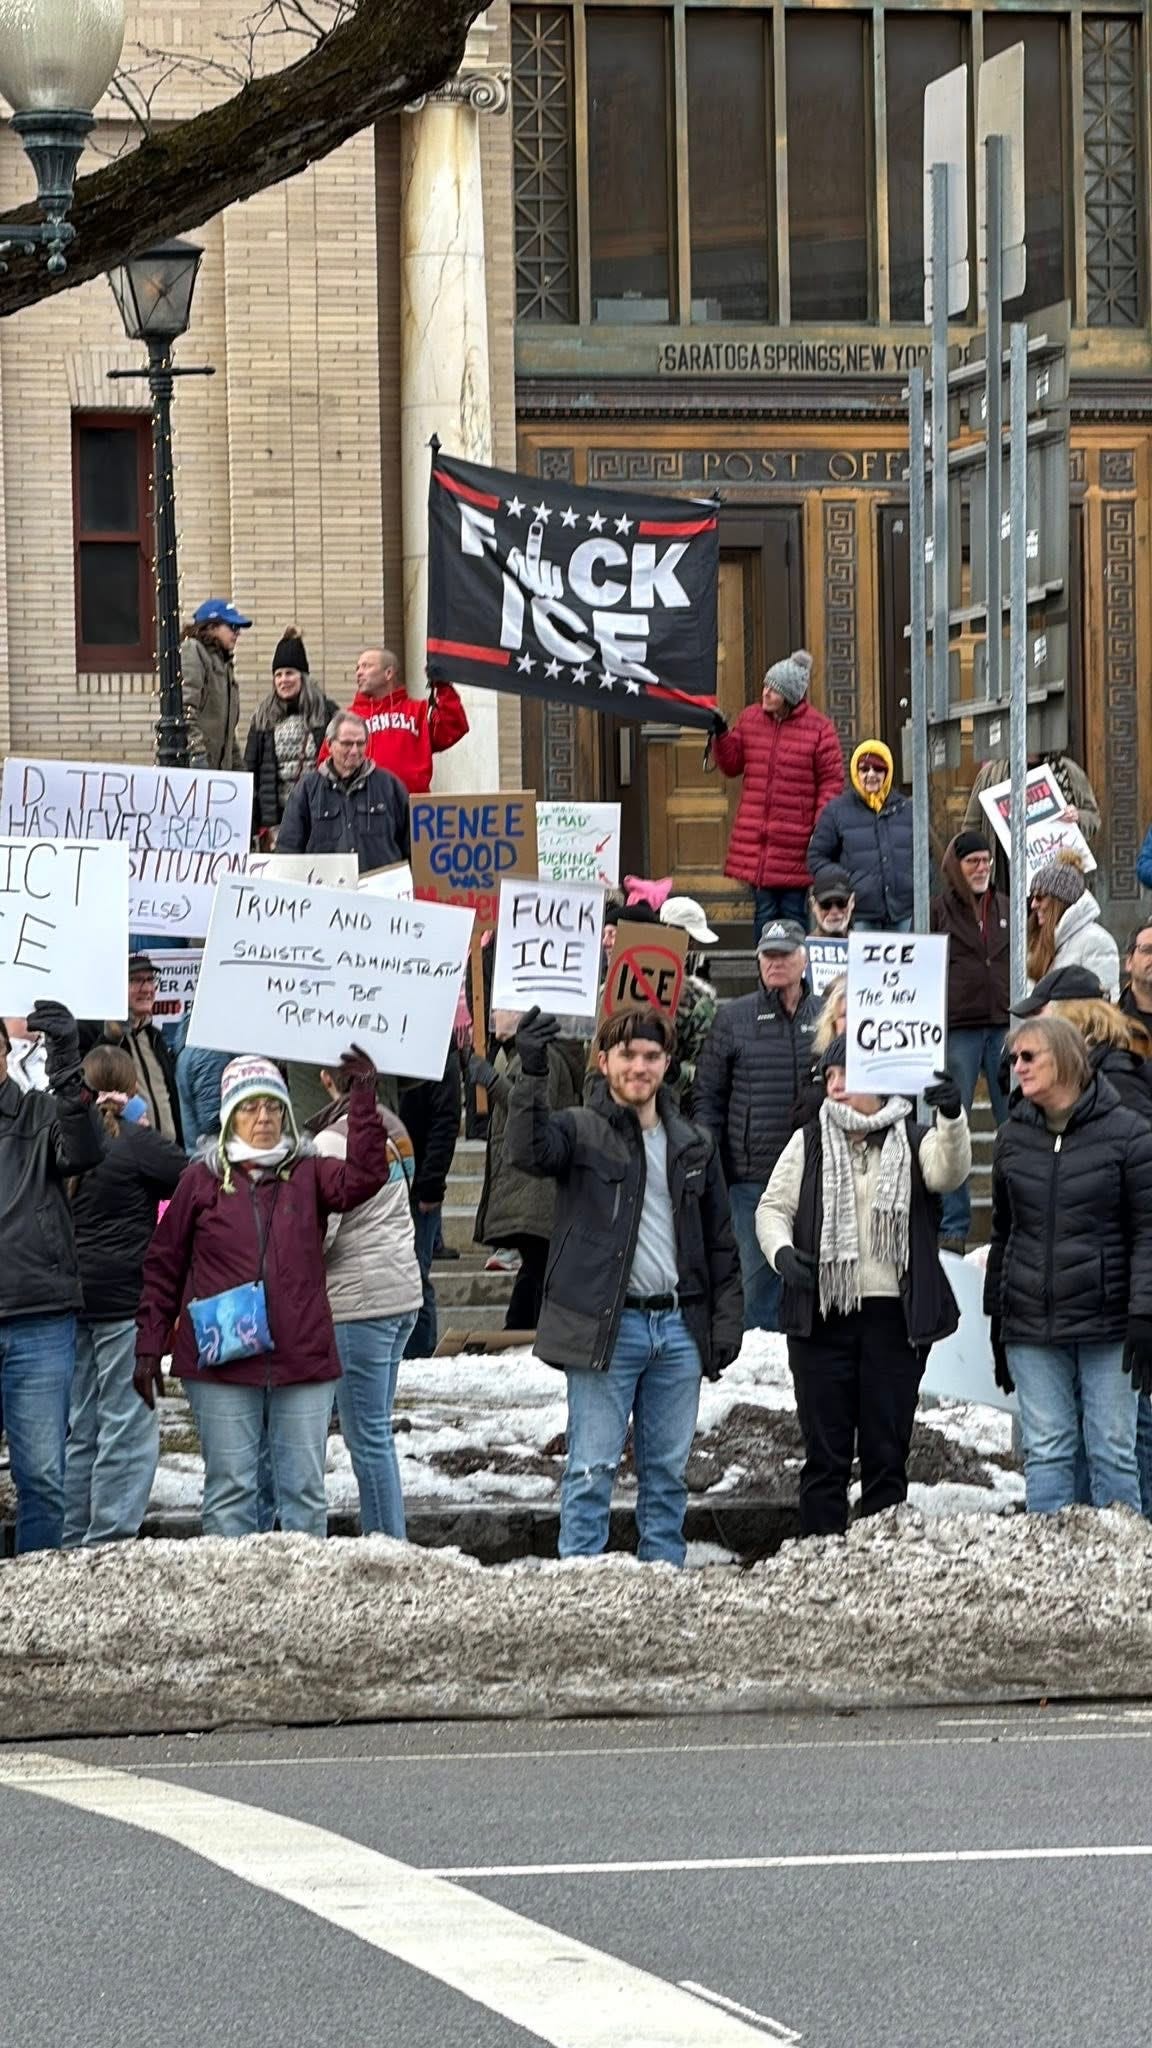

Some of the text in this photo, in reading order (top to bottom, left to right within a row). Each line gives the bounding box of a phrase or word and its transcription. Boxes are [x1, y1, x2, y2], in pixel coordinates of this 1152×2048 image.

[664, 343, 761, 372] SARATOGA
[846, 343, 887, 372] NEW
[892, 343, 933, 371] YOR
[703, 450, 903, 481] POST OFF
[500, 572, 660, 685] ICE
[365, 711, 419, 737] RNELL
[22, 765, 238, 818] D TRUMP
[8, 803, 59, 840] HAS
[63, 807, 153, 850] NEVER
[411, 803, 526, 843] RENEE
[129, 847, 249, 885] TITUTION
[429, 838, 518, 875] GOOD
[448, 872, 495, 890] WAS
[230, 884, 427, 939] TRUMP AND HIS
[512, 891, 595, 937] FUCK
[512, 937, 585, 974] ICE
[863, 942, 916, 965] ICE
[184, 979, 198, 993] A
[267, 976, 384, 1002] MUST BE
[616, 962, 676, 1009] ICE
[882, 969, 901, 988] IS
[184, 1000, 194, 1013] F
[856, 1017, 943, 1054] GESTPO
